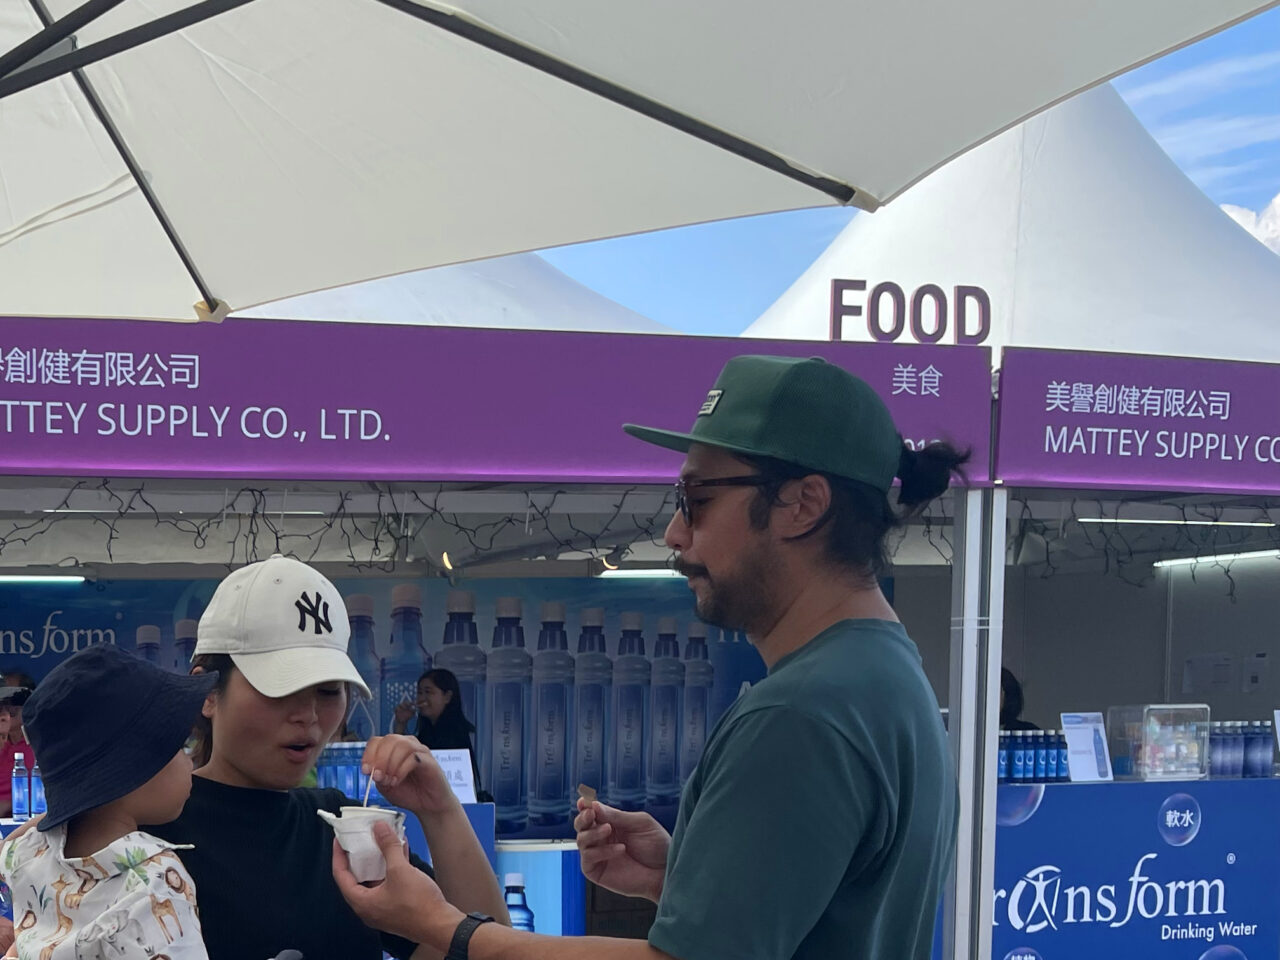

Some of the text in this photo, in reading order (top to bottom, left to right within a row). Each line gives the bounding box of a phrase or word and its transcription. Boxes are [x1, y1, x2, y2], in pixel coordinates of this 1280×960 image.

[829, 279, 991, 346] FOOD
[891, 363, 944, 399] 美食
[1046, 380, 1231, 420] 美譽創健有限公司
[97, 402, 231, 439] SUPPLY
[240, 406, 307, 443] CO.,
[320, 408, 391, 442] LTD.
[1045, 425, 1149, 457] MATTEY
[1155, 430, 1250, 463] SUPPLY
[295, 591, 333, 635] NY
[1165, 809, 1194, 828] 軟水
[992, 853, 1228, 933] ransform
[1161, 921, 1258, 943] Drinking Water
